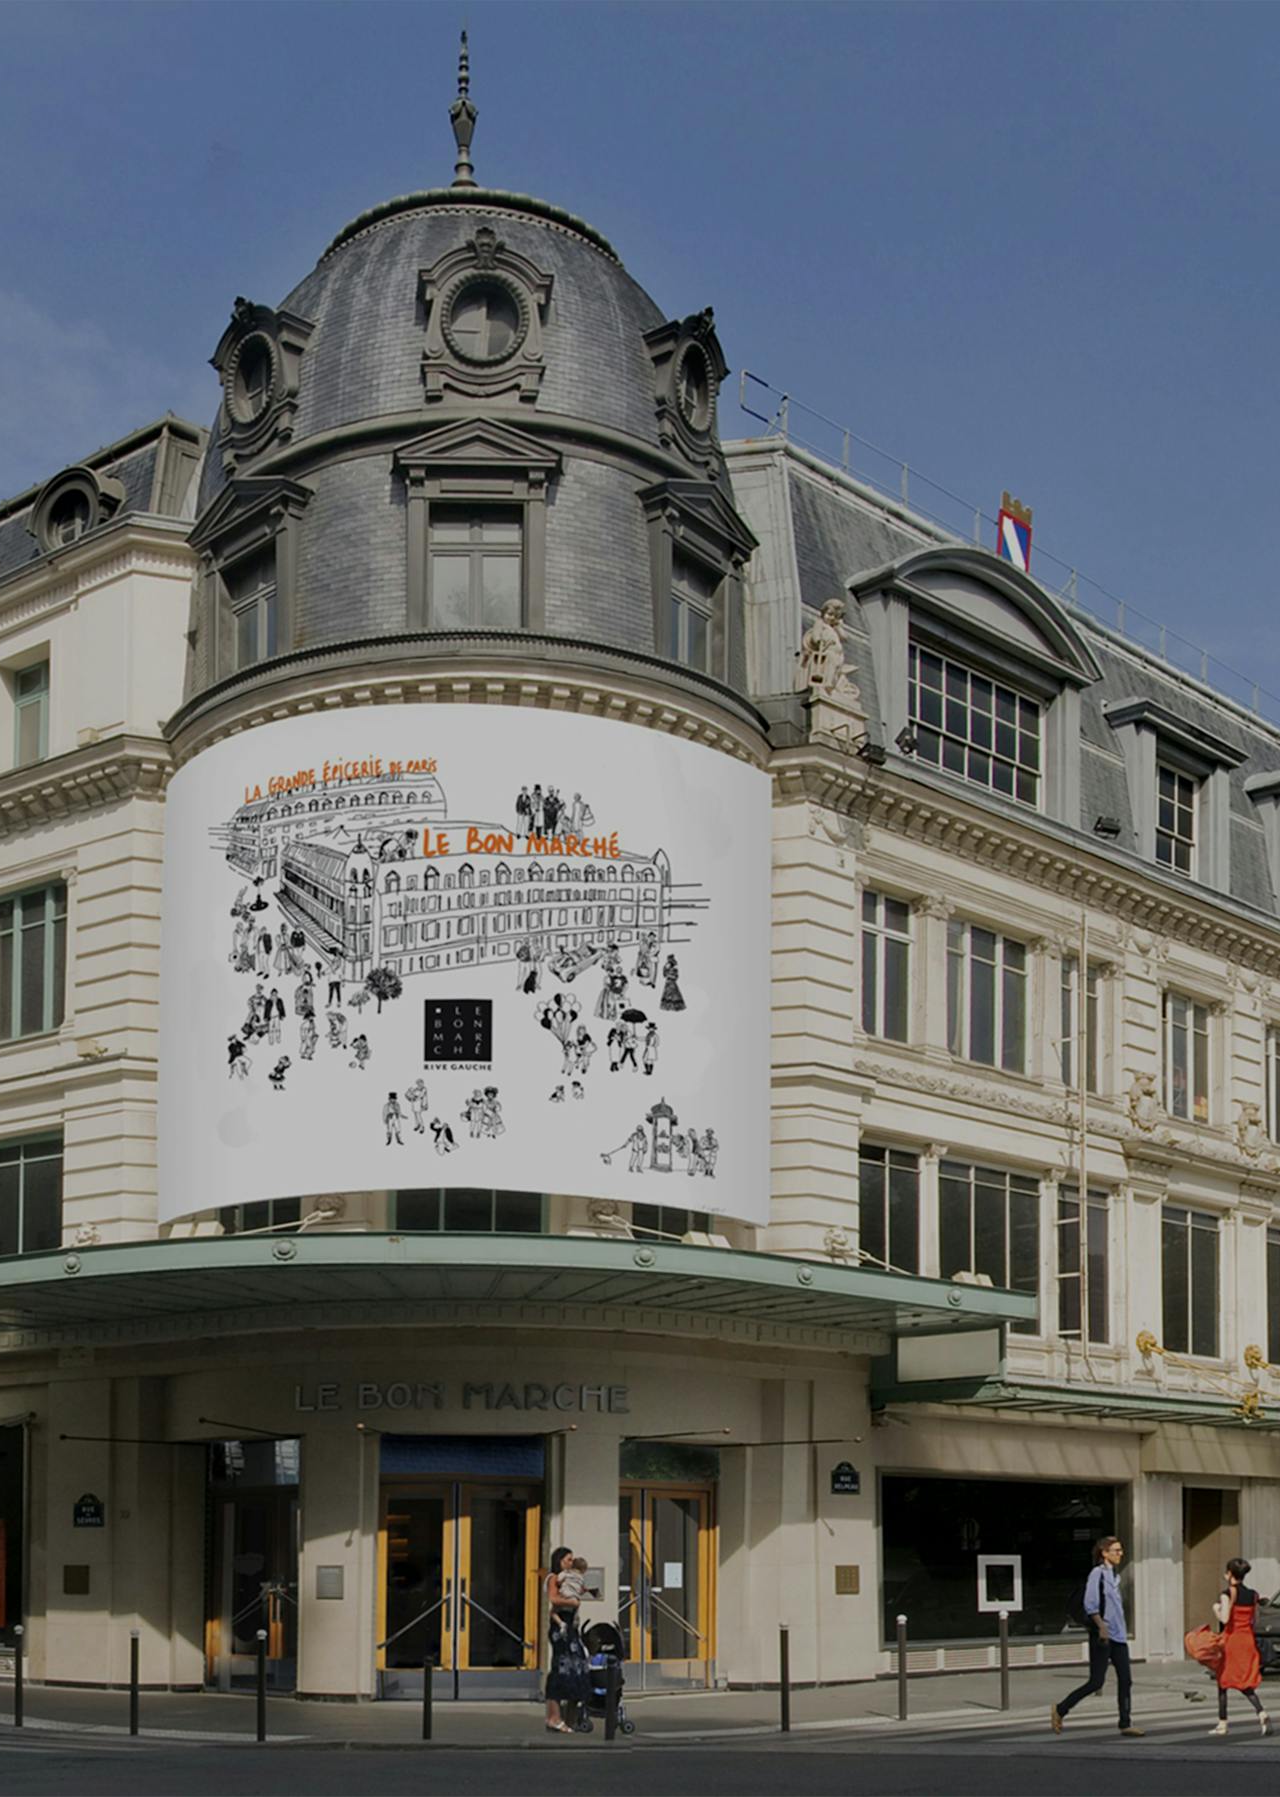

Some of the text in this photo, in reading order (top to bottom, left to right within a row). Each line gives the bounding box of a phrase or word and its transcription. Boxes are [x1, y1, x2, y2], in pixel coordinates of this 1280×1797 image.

[245, 784, 262, 804] LA
[268, 769, 316, 794] GRANDE
[389, 761, 403, 776] DE
[406, 757, 438, 774] PARIS
[423, 826, 621, 859] LE BON MARCHÉ
[423, 1063, 492, 1072] RIVE GAUCHE
[294, 1382, 631, 1414] LE BON MARCHE
